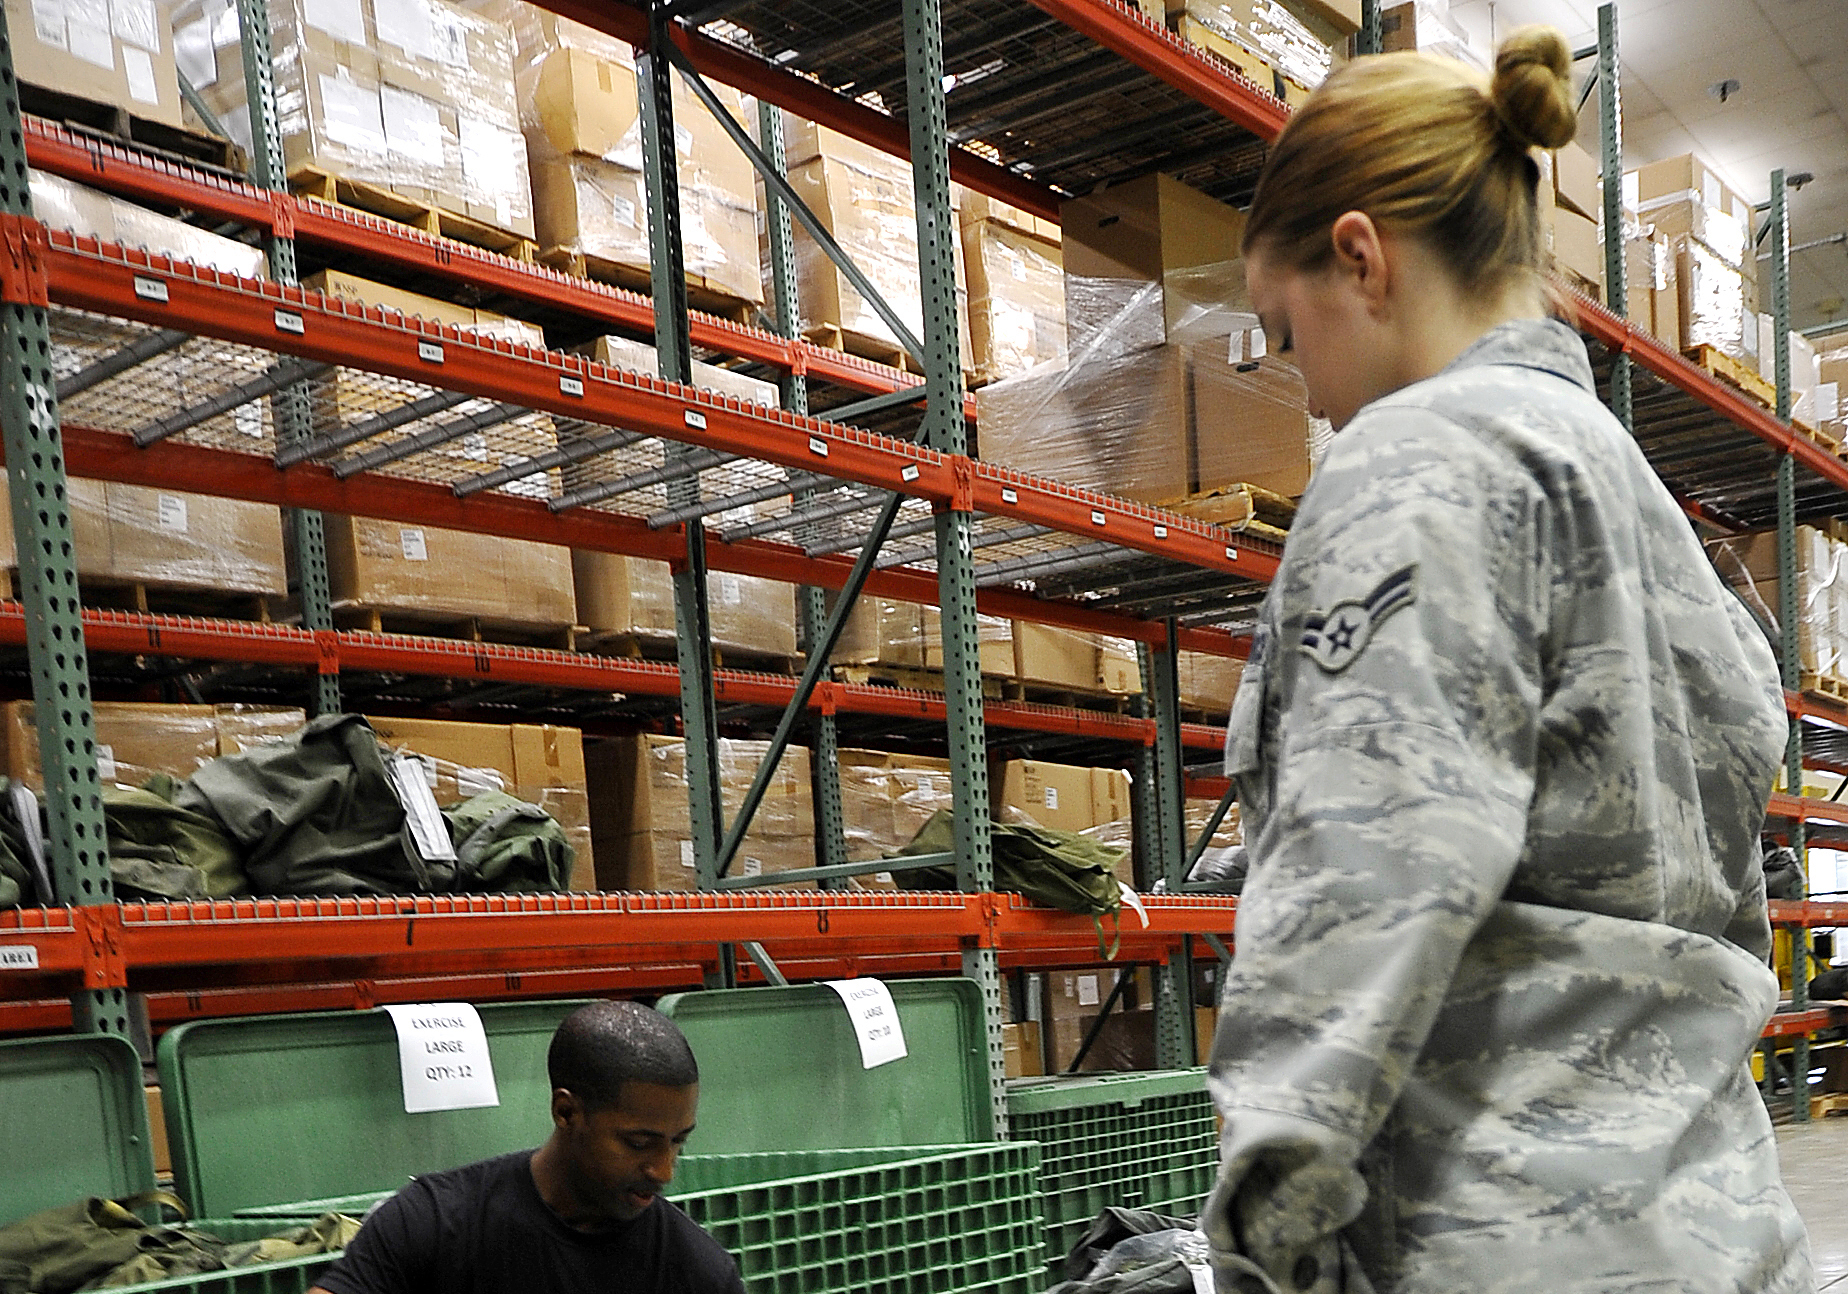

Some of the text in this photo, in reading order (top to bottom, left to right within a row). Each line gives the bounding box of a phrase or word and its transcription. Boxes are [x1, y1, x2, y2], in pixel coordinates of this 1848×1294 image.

[411, 1016, 466, 1029] EXERCISE
[425, 1040, 466, 1055] LARGE
[426, 1064, 474, 1082] QTY: 12
